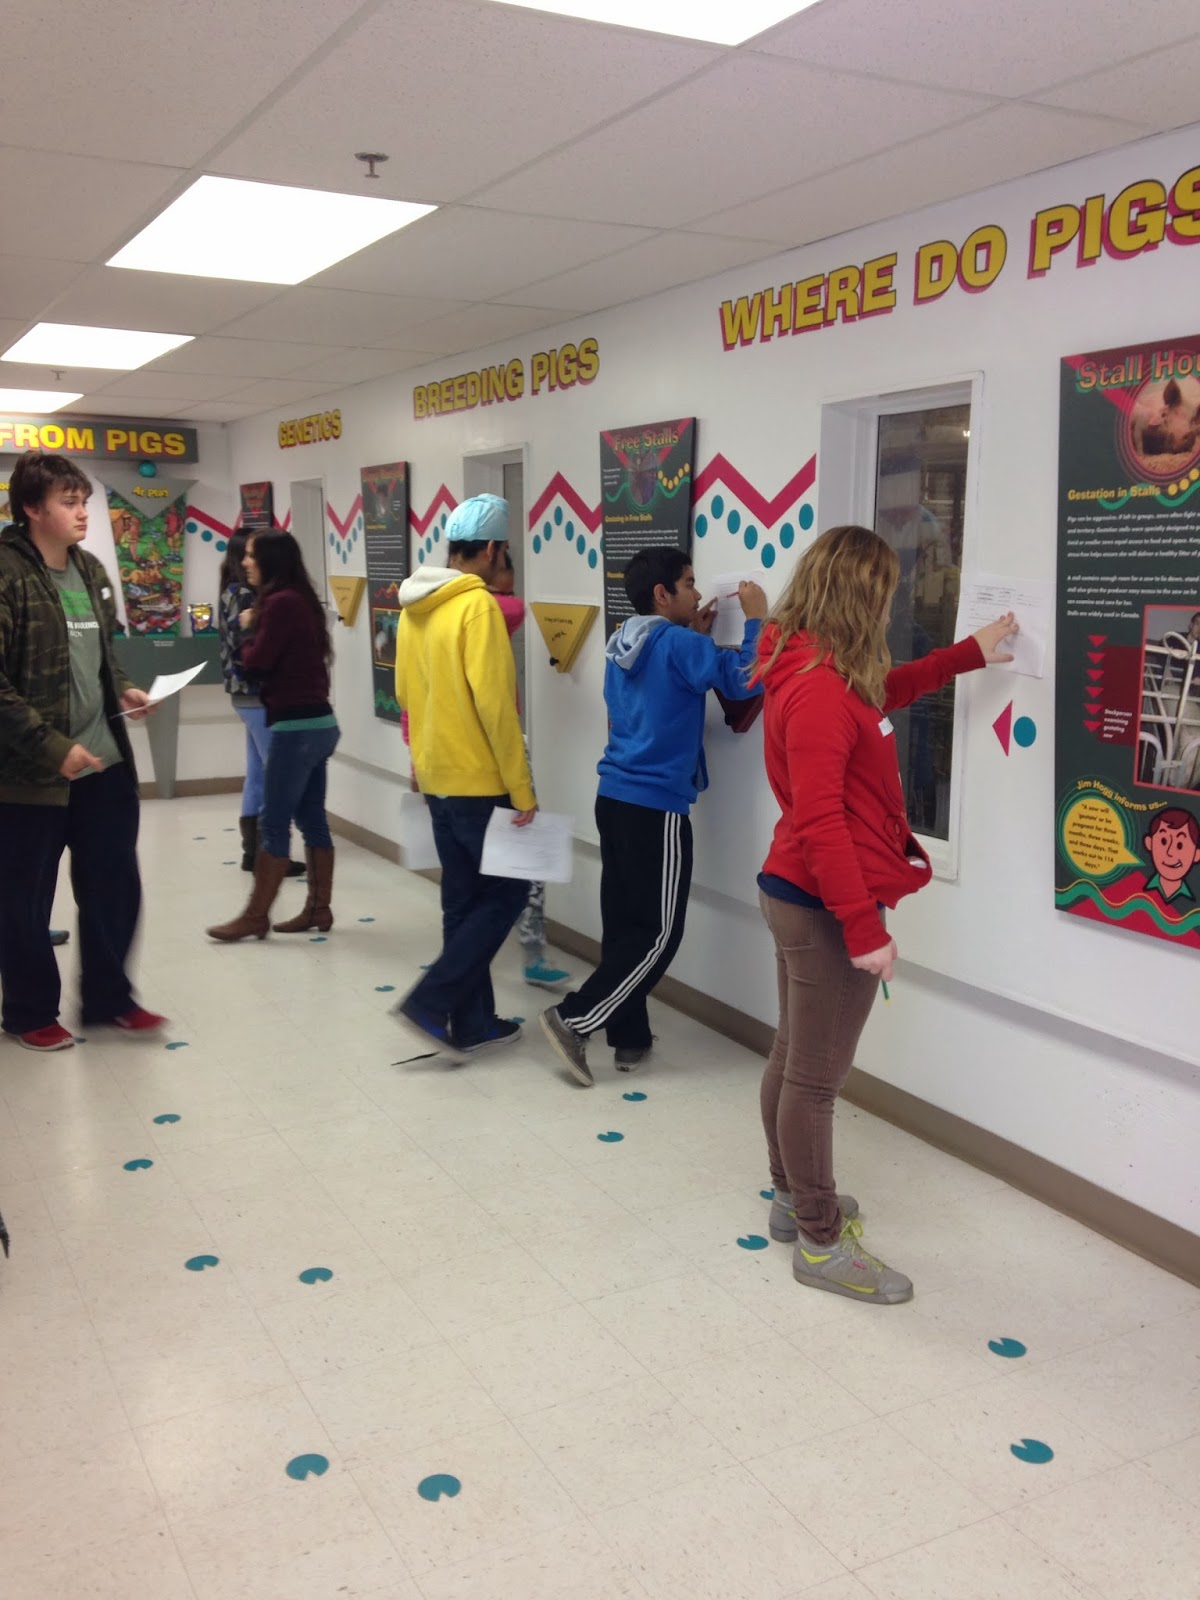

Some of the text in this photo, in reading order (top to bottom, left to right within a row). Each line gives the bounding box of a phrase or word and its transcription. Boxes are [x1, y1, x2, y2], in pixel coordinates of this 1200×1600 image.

[720, 165, 1200, 351] WHERE DO PIGS
[413, 338, 599, 421] BREEDING PIGS
[1076, 354, 1142, 393] Stall
[0, 422, 186, 456] FROM PIGS
[278, 409, 342, 449] GENETICS
[613, 427, 678, 453] Free Stalls
[1068, 484, 1160, 500] Gestation in Stalls
[1077, 780, 1091, 790] Jim
[1093, 780, 1114, 799] Hogg
[1114, 793, 1146, 810] informs
